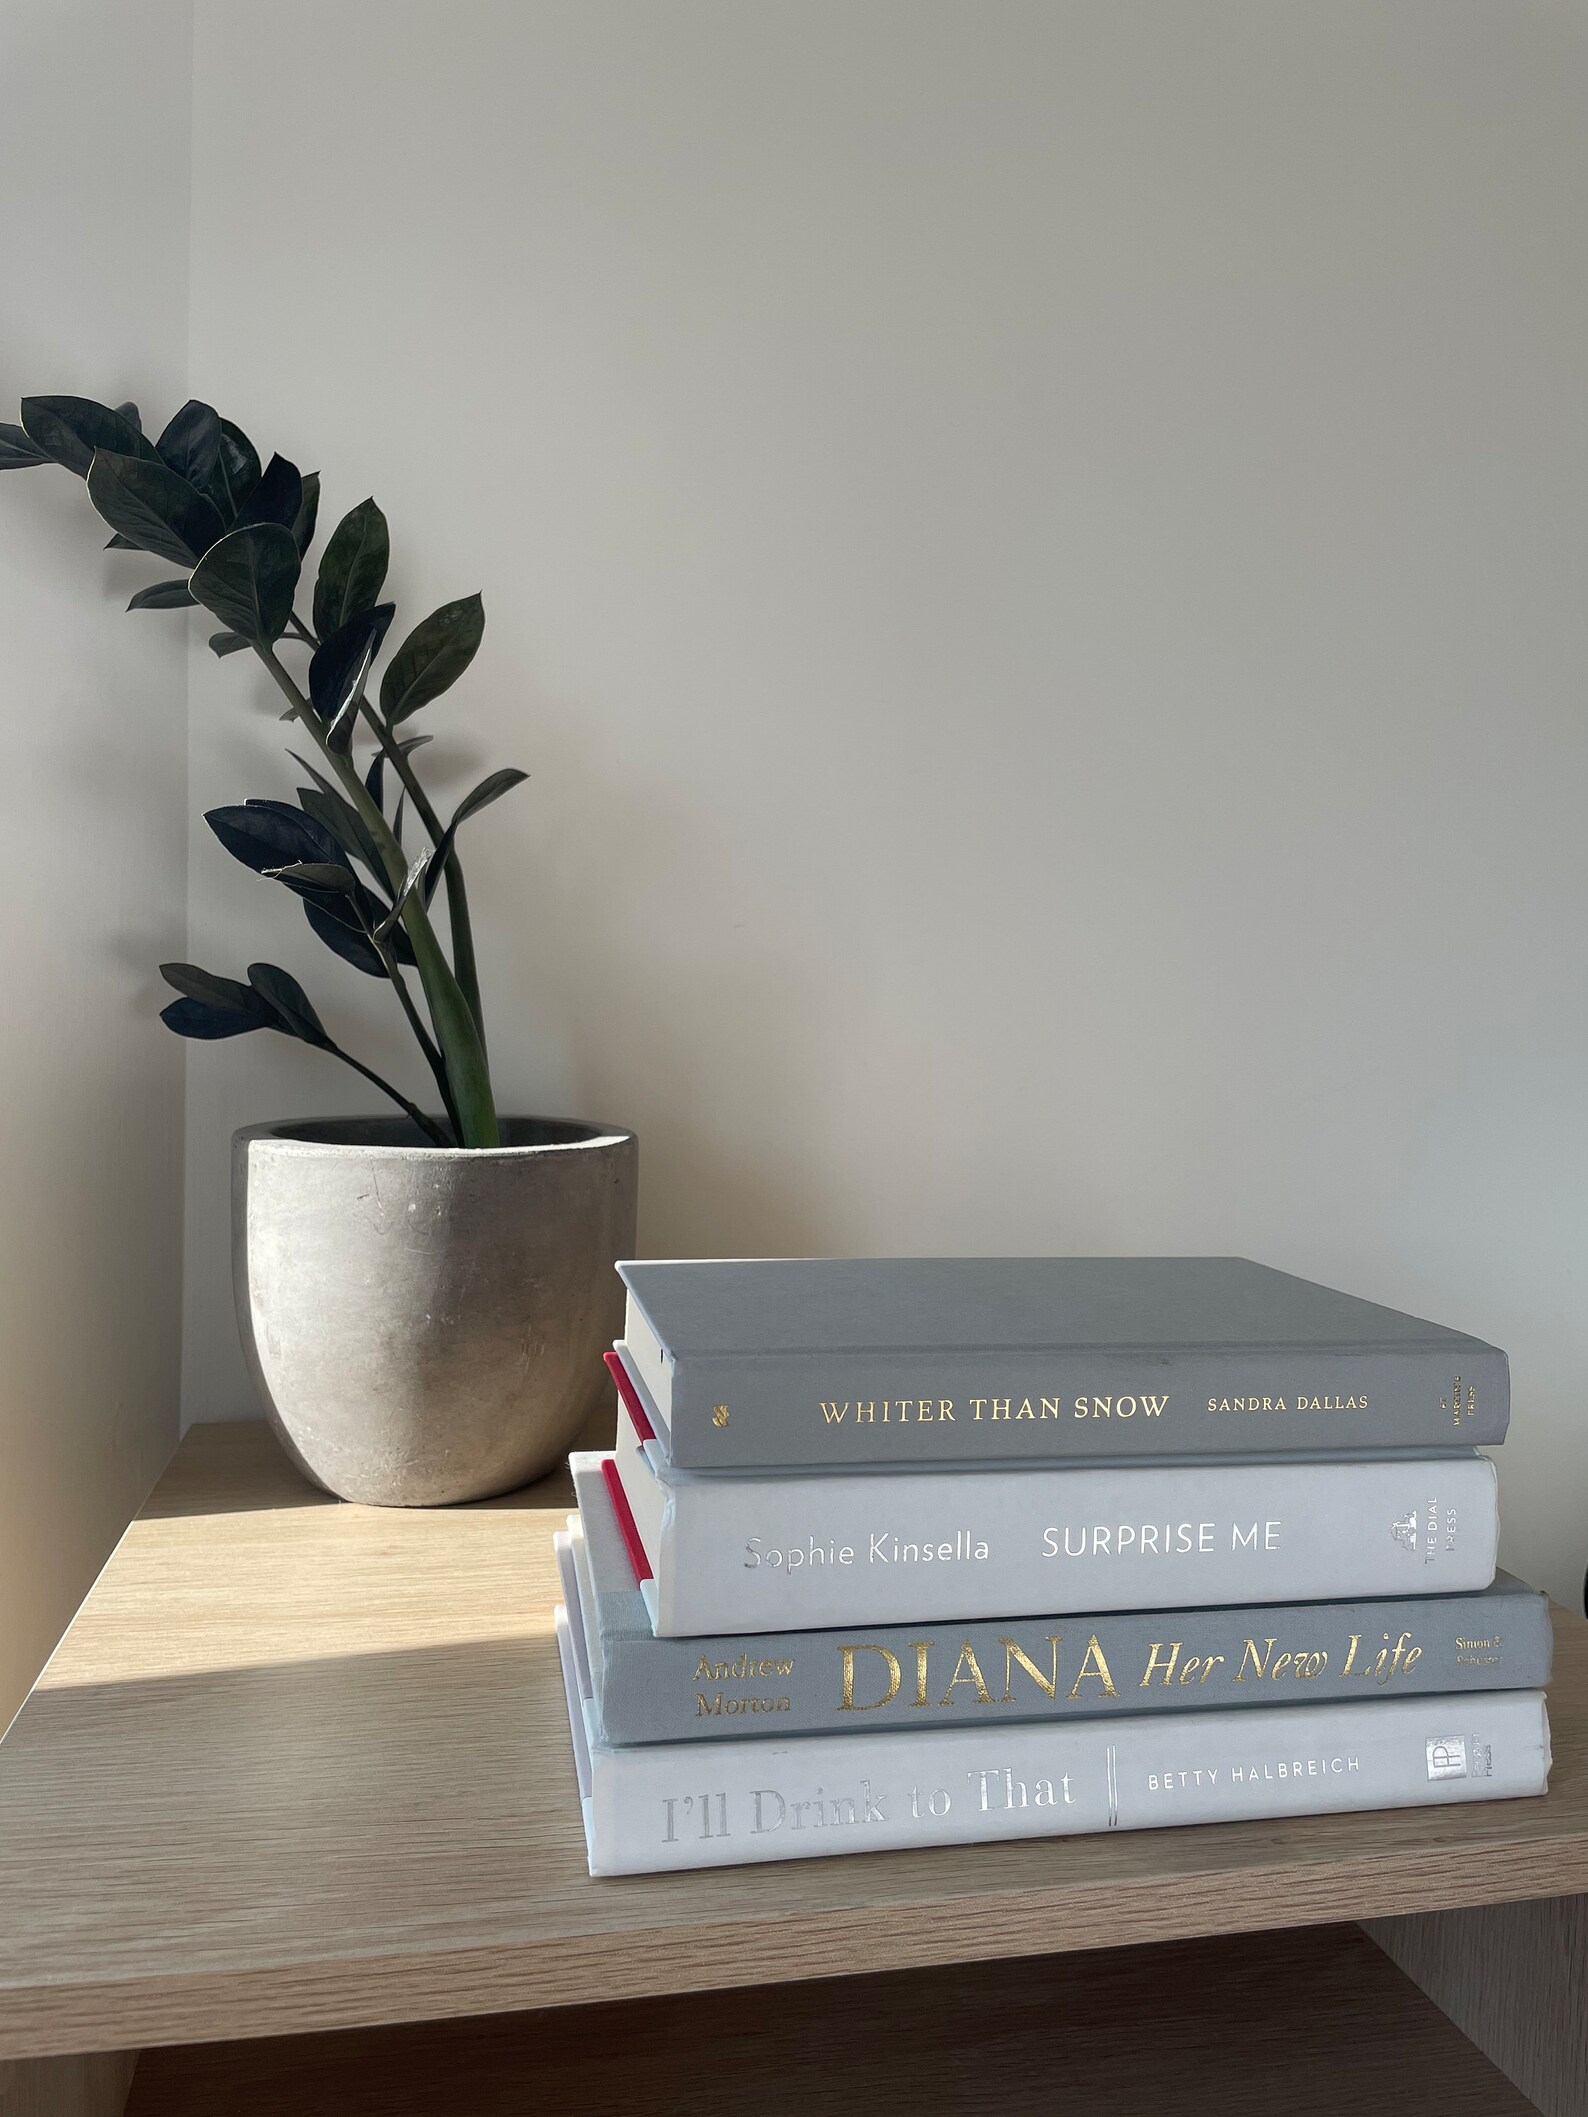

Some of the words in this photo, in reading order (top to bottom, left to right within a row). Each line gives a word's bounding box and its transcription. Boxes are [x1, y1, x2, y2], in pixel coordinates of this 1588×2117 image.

[819, 1399, 956, 1424] WHITER
[969, 1397, 1061, 1420] THAN
[1074, 1395, 1170, 1418] SNOW
[1207, 1397, 1287, 1412] SANDRA
[1296, 1395, 1369, 1410] DALLAS
[1427, 1496, 1438, 1531] DIAL
[1445, 1508, 1457, 1552] PRESS
[743, 1534, 855, 1576] Sophie
[869, 1530, 990, 1564] Kinsella
[1041, 1523, 1216, 1558] SURPRISE
[1231, 1521, 1282, 1551] ME
[1424, 1536, 1438, 1565] THE
[1455, 1637, 1490, 1650] Simon
[693, 1653, 795, 1681] Andrew
[834, 1634, 1120, 1711] DIANA
[1139, 1641, 1224, 1687] Her
[1232, 1638, 1328, 1682] New
[1339, 1632, 1423, 1686] Life
[695, 1692, 792, 1717] Morton
[1148, 1768, 1219, 1790] BETTY
[1231, 1756, 1360, 1783] HALBREICH
[662, 1792, 731, 1842] I'll
[750, 1779, 888, 1834] Drink
[907, 1786, 951, 1818] to
[967, 1767, 1077, 1812] That
